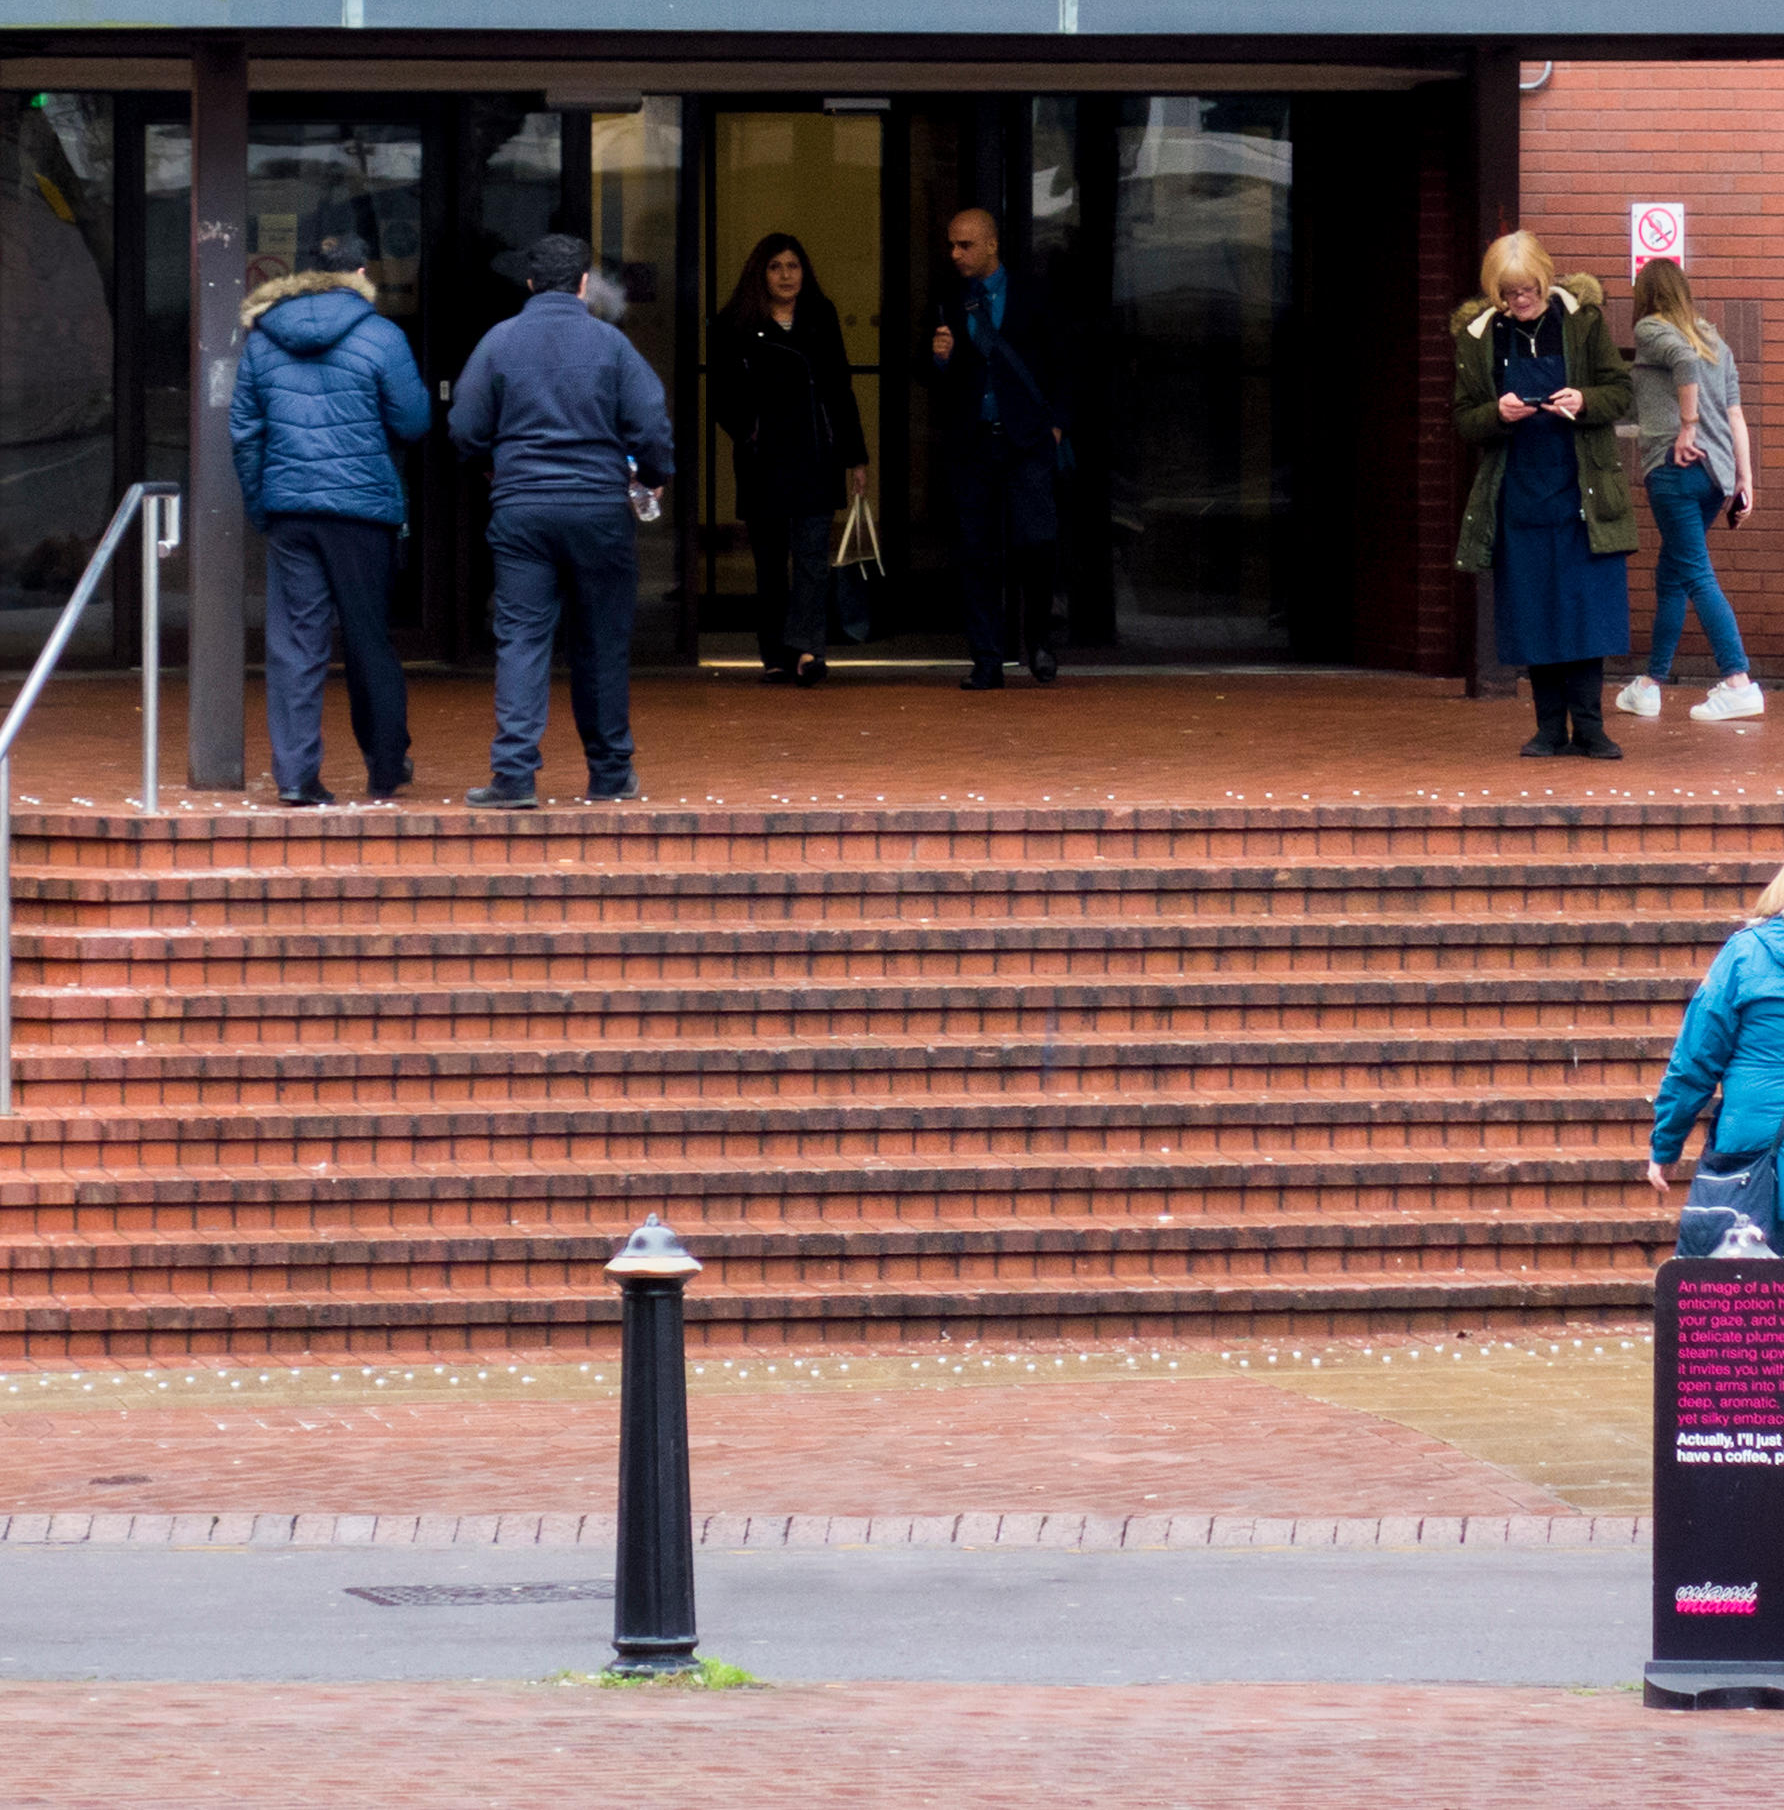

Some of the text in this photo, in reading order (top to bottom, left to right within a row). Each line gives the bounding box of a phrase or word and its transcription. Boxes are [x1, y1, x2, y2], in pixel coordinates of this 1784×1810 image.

[1679, 1280, 1697, 1292] An
[1700, 1281, 1741, 1296] image
[1744, 1281, 1757, 1293] of
[1760, 1284, 1769, 1293] a
[1678, 1298, 1730, 1312] enticing
[1734, 1298, 1775, 1311] potion
[1678, 1315, 1706, 1328] your
[1751, 1315, 1776, 1326] and
[1678, 1333, 1687, 1342] a
[1691, 1331, 1742, 1342] delicate
[1678, 1348, 1718, 1359] steam
[1721, 1347, 1757, 1362] rising
[1678, 1363, 1686, 1375] it
[1689, 1363, 1731, 1375] invites
[1734, 1365, 1758, 1378] you
[1677, 1381, 1711, 1394] open
[1715, 1381, 1748, 1392] arms
[1751, 1380, 1776, 1392] into
[1677, 1413, 1697, 1427] yet
[1701, 1412, 1729, 1427] silky
[1677, 1432, 1782, 1449] Actually, I'll just
[1677, 1448, 1710, 1462] have
[1713, 1452, 1722, 1462] a
[1724, 1450, 1772, 1465] coffee,
